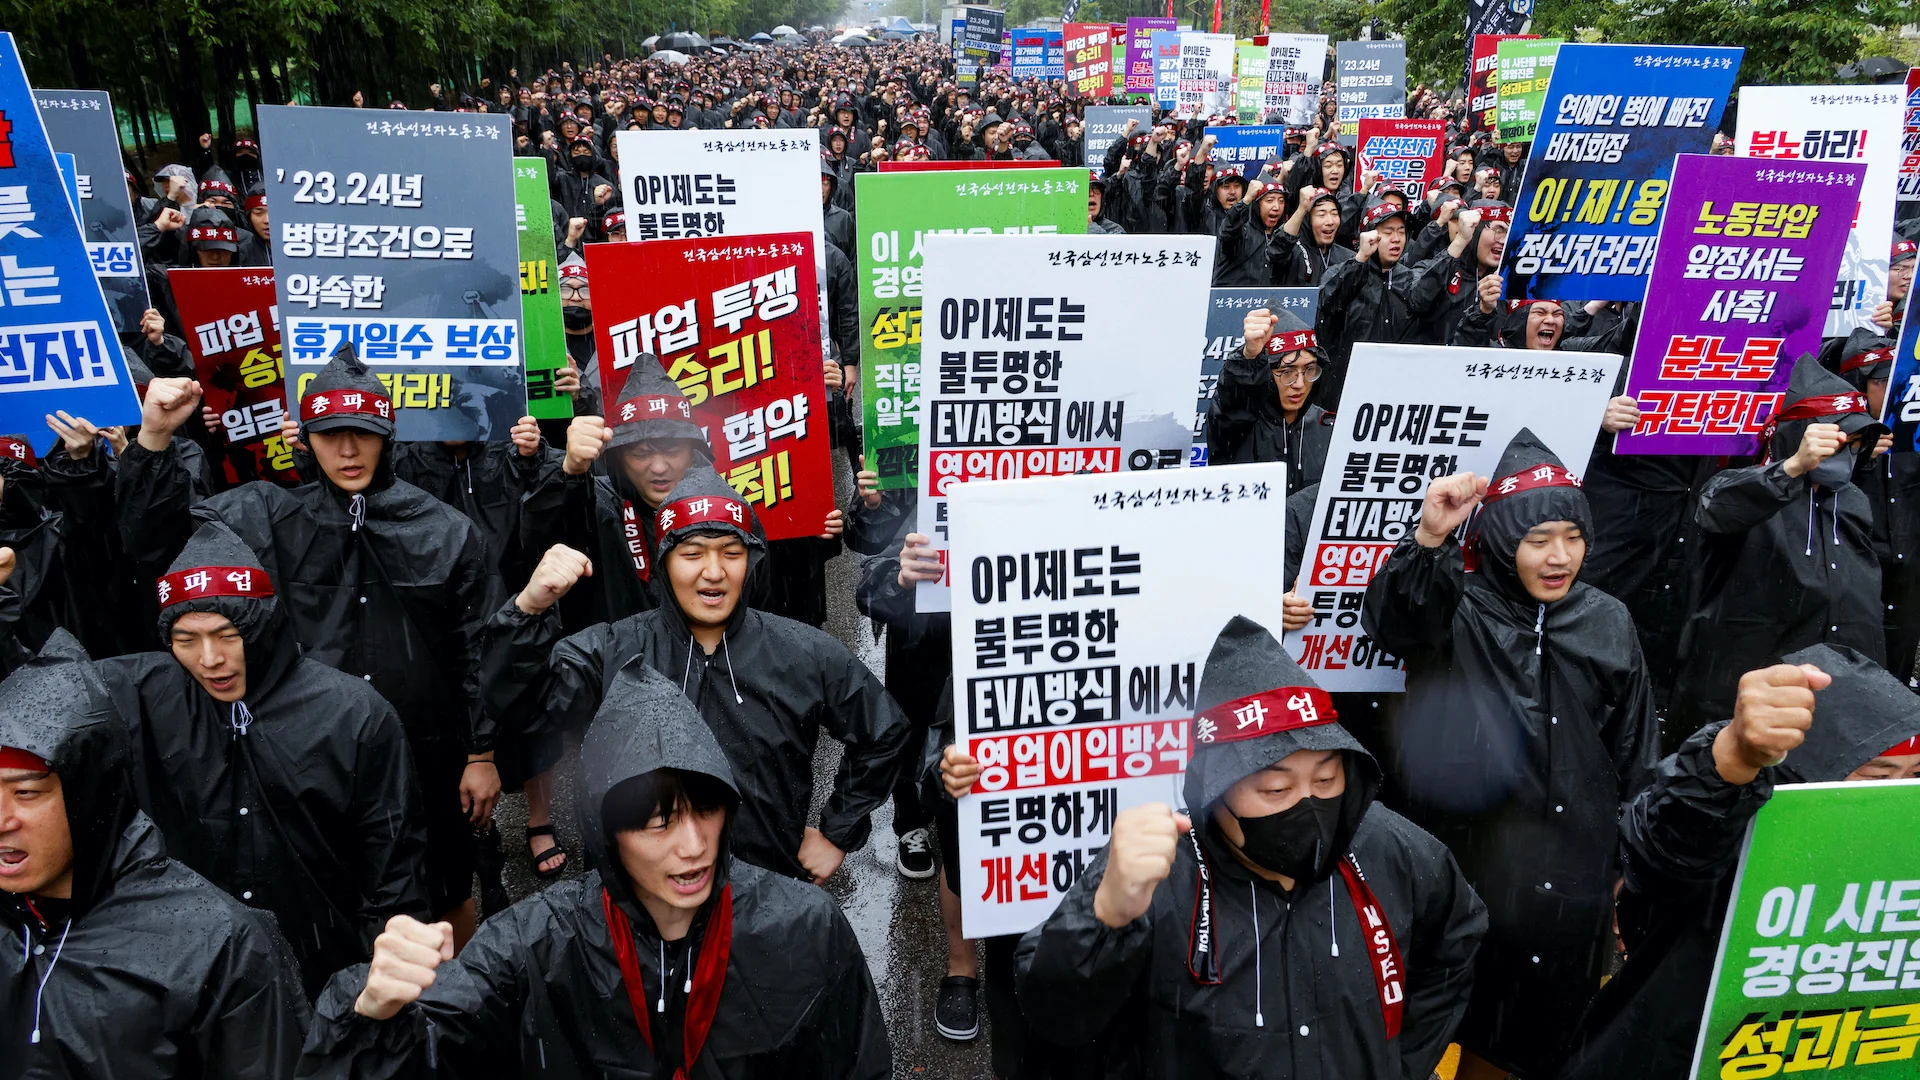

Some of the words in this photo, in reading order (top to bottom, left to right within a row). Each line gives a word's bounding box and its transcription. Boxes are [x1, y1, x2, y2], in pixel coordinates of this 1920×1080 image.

[1066, 37, 1086, 52] 파업
[1088, 32, 1108, 46] 투쟁
[1134, 39, 1152, 49] 앞장
[1159, 44, 1180, 56] 노조
[1271, 47, 1301, 58] OPI제도는
[1076, 45, 1102, 63] 승리!
[1159, 59, 1180, 70] 과거
[1269, 59, 1295, 70] 불투명한
[1501, 58, 1509, 68] 이
[1512, 57, 1537, 68] 사단을
[1633, 56, 1733, 70] 전국삼성전자노동조합
[1067, 67, 1086, 82] 임금
[1089, 61, 1109, 76] 협약
[1132, 61, 1154, 74] 분노
[1267, 71, 1293, 82] EVA방식
[1294, 71, 1308, 82] 에서
[1341, 60, 1381, 71] '23.24년
[1501, 68, 1534, 79] 경영진은
[1077, 74, 1104, 93] 쟁취!
[1160, 72, 1179, 83] 못버
[1340, 75, 1393, 88] 병합조건으로
[1500, 81, 1532, 96] 성과금
[1265, 83, 1305, 95] 영업이익방식
[1306, 85, 1320, 95] 으로
[1340, 91, 1367, 103] 약속한
[1810, 94, 1899, 105] 전국삼성전자노동조합
[35, 98, 101, 111] 전자노동조합
[1265, 95, 1291, 106] 투명하게
[1500, 99, 1525, 110] 직원은
[1555, 94, 1621, 127] 연예인
[1620, 95, 1662, 127] 병에
[1663, 97, 1714, 128] 빠진
[1340, 105, 1380, 119] 휴가일수
[1383, 105, 1403, 119] 보상
[1500, 111, 1517, 122] 알수
[1519, 110, 1536, 120] 없는
[366, 121, 500, 140] 전국삼성전자노동조합
[703, 139, 811, 153] 전국삼성전자노동조합
[1088, 139, 1116, 150] 병합조
[1210, 147, 1237, 161] 연예인
[1239, 146, 1257, 160] 병에
[1258, 146, 1277, 160] 빠진
[1366, 136, 1437, 157] 삼성전자
[1544, 133, 1631, 164] 바지회장
[1749, 130, 1868, 160] 분노하라!
[1088, 154, 1104, 165] 약속
[1373, 159, 1425, 179] 직원은
[955, 180, 1079, 197] 전국삼성전자노동조합
[1755, 169, 1856, 186] 전국삼성전자노동조합
[634, 173, 736, 206] OPI제도는
[1693, 201, 1819, 239] 노동탄압
[282, 223, 474, 259] 병합조건으로
[871, 231, 899, 263] 이
[683, 243, 805, 263] 전국삼성전자노동조합
[1048, 250, 1202, 268] 전국삼성전자노동조합
[1515, 233, 1657, 277] 정신차려라
[1683, 244, 1805, 283] 앞장서는
[286, 274, 385, 309] 약속한
[609, 299, 699, 371] 파업
[711, 265, 800, 336] 투쟁
[1700, 290, 1778, 325] 사측!
[940, 297, 1085, 341] OPI제도는
[195, 310, 264, 357] 파업
[292, 322, 434, 361] 휴가일수
[445, 324, 516, 361] 보상
[239, 345, 286, 389] 승
[666, 329, 775, 408] 승리!
[1658, 335, 1786, 382] 분노로
[939, 350, 1063, 394] 불투명한
[1465, 363, 1606, 384] 전국삼성전자노동조합
[311, 392, 391, 418] 총파업
[620, 397, 693, 419] 총파업
[221, 398, 286, 442] 임금
[722, 393, 810, 462] 협약
[937, 401, 1053, 446] EVA방식
[1066, 400, 1125, 442] 에서
[1352, 402, 1490, 448] OPI제도는
[1093, 482, 1271, 511] 전국삼성전자노동조합
[659, 498, 743, 530] 총파업
[1327, 500, 1424, 542] EVA방
[623, 505, 646, 571] NSEU
[971, 546, 1141, 604] OPI제도는
[157, 570, 252, 603] 총파업
[974, 608, 1119, 669] 불투명한
[974, 669, 1113, 731] EVA방식
[1128, 662, 1195, 715] 에서
[1196, 691, 1319, 744] 총파업
[976, 723, 1190, 792] 영업이익방식
[979, 787, 1118, 847] 투명하게
[980, 845, 1104, 905] 개선하
[1755, 884, 1816, 938] 이
[1363, 904, 1404, 1005] NSEU
